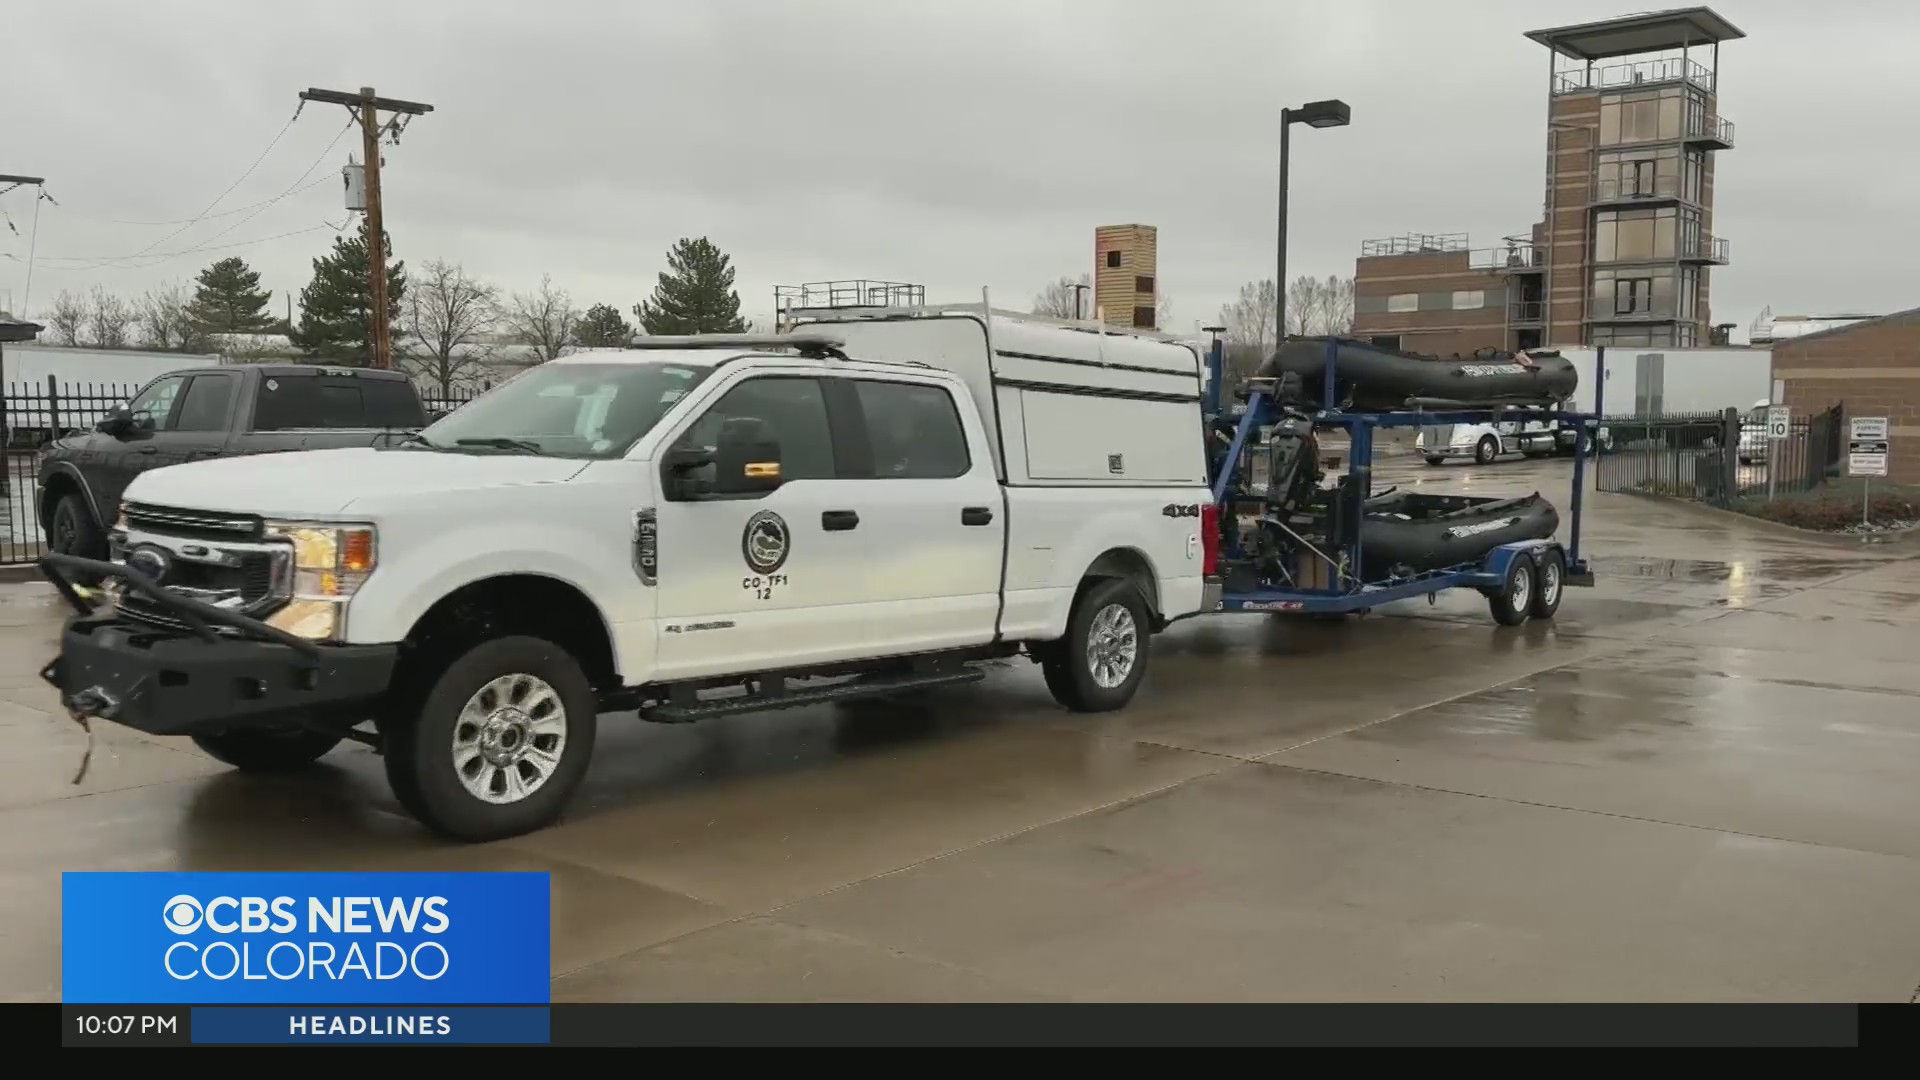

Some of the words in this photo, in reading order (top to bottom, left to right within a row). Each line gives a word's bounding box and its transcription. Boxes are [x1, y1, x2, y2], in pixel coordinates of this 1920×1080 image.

[1770, 423, 1785, 436] 10
[742, 575, 788, 590] CO-TF1
[756, 587, 772, 600] 12
